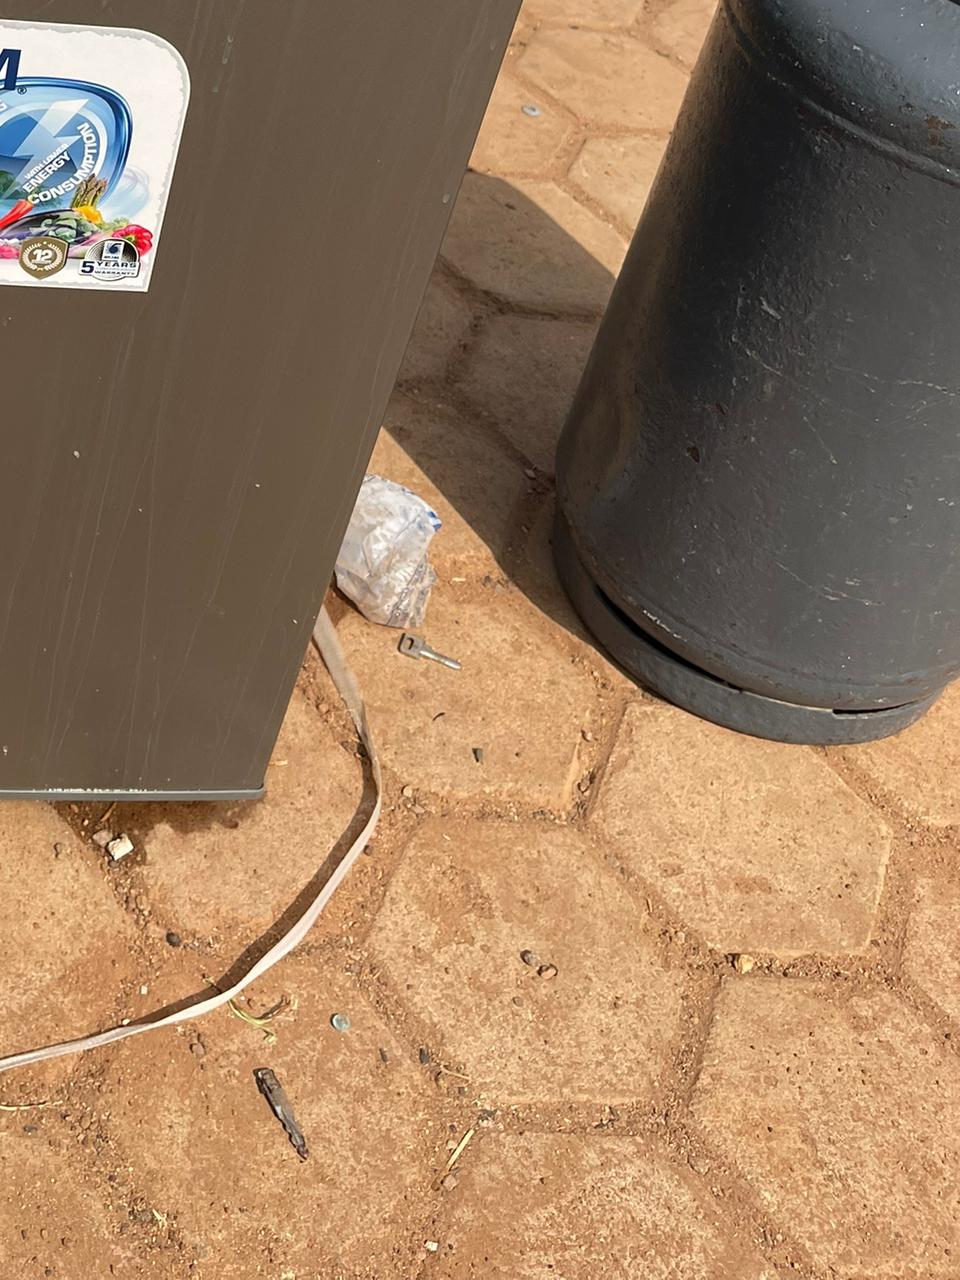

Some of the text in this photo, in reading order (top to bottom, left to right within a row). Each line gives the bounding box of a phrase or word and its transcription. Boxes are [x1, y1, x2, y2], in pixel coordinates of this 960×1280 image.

[22, 150, 70, 193] ENERGY
[27, 123, 97, 205] CONSUMPTION
[33, 248, 53, 262] 12
[81, 261, 95, 274] 5
